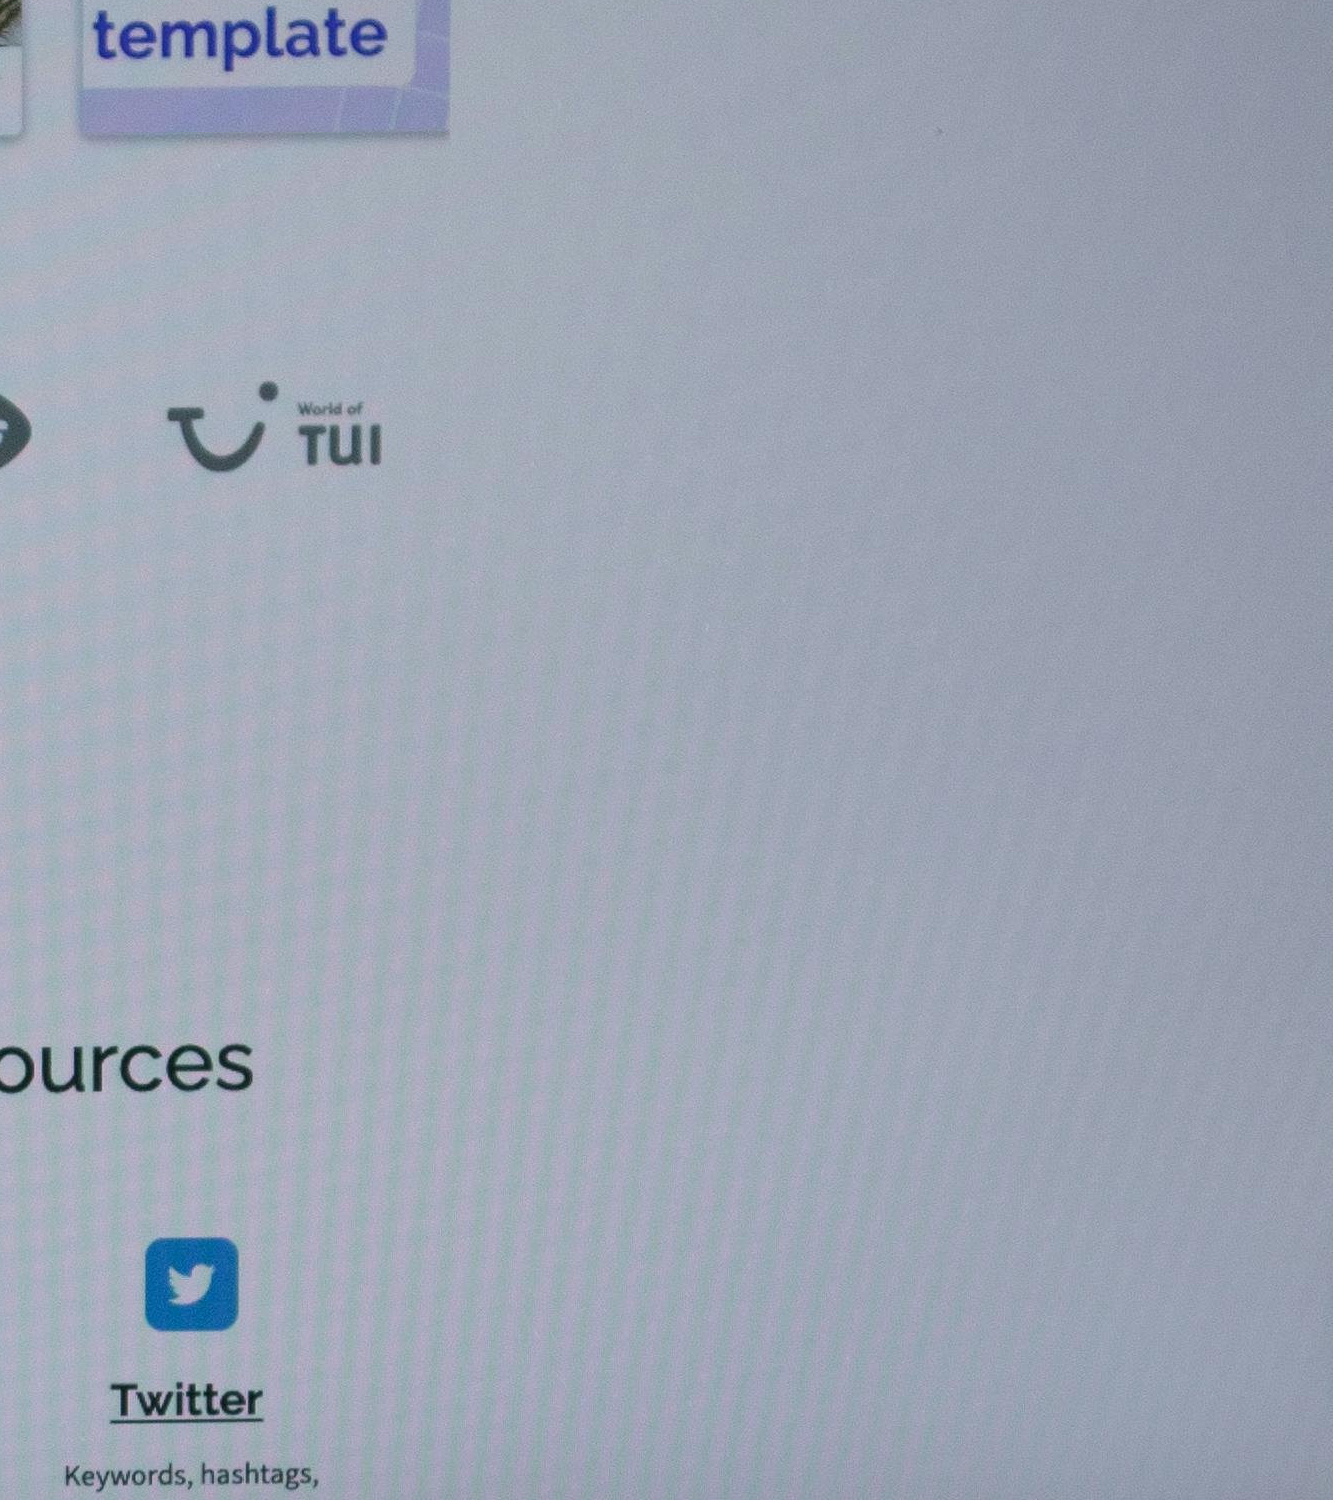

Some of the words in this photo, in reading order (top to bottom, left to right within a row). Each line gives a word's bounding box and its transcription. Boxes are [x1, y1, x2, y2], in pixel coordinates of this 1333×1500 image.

[91, 4, 388, 73] template
[297, 402, 343, 417] World
[346, 401, 364, 417] of
[297, 423, 382, 467] TUI
[110, 1381, 264, 1418] Twitter
[64, 1461, 194, 1493] Keywords,
[200, 1461, 320, 1492] hashtags,
